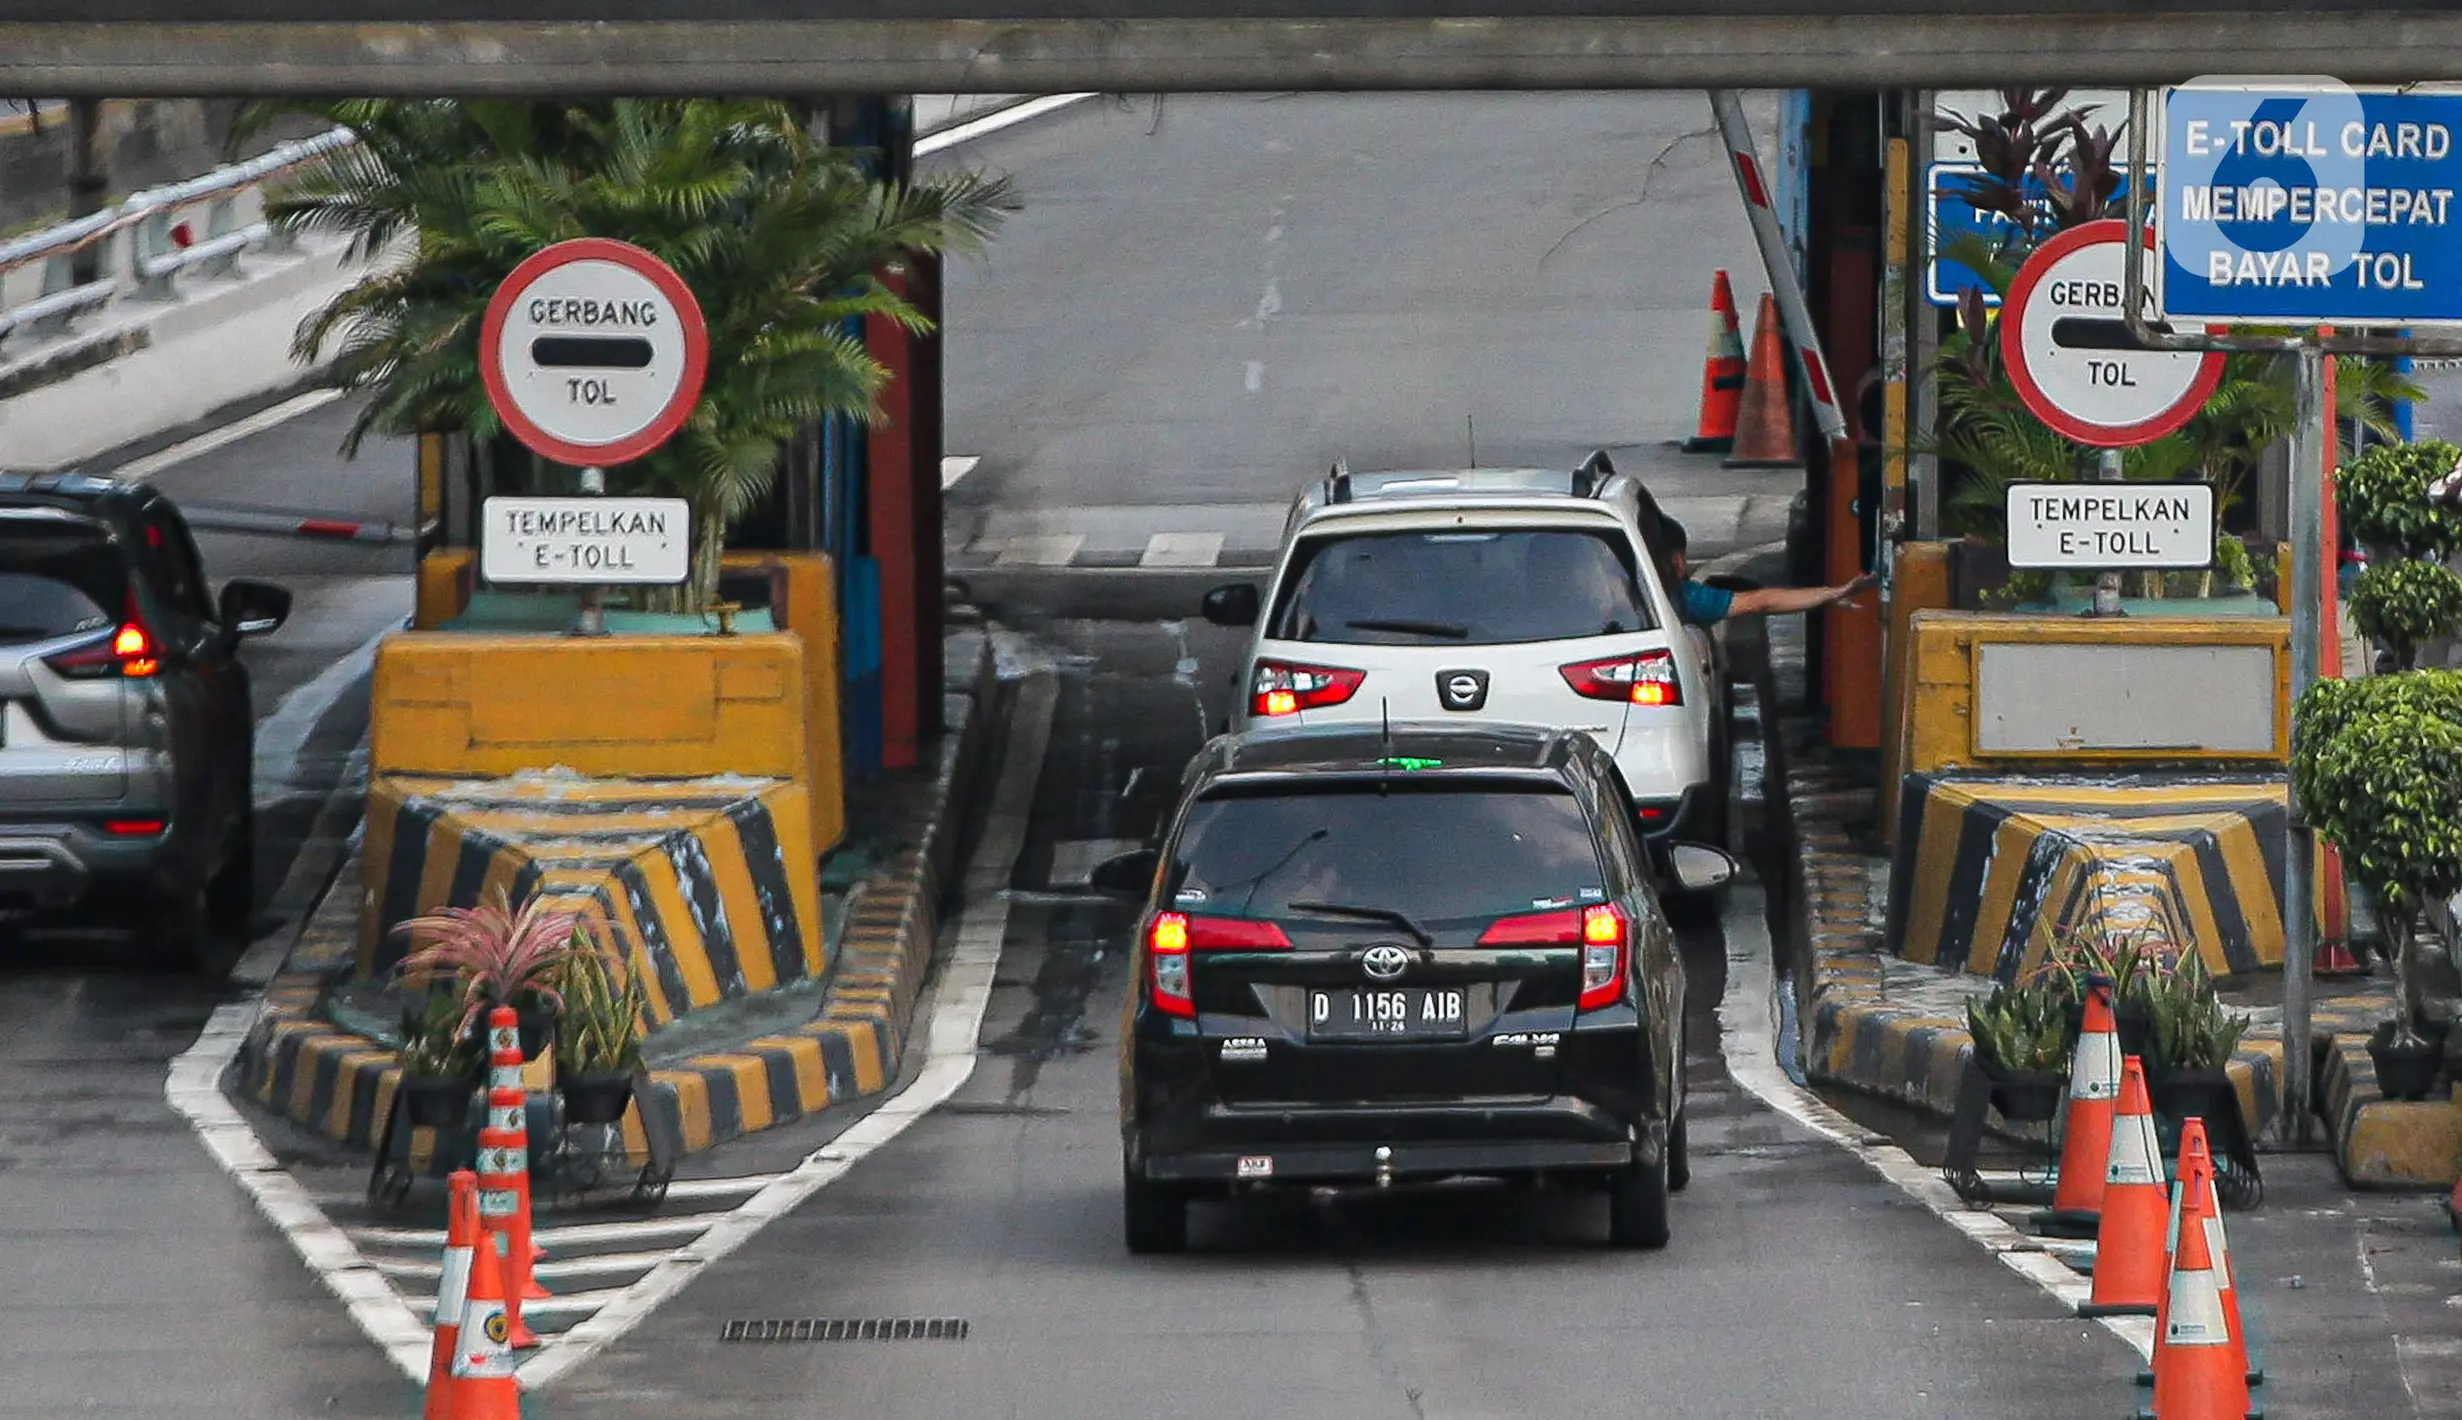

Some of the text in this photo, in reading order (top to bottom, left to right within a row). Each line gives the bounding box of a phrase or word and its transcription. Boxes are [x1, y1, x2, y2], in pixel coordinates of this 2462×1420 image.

[2186, 120, 2452, 160] E-TOLL CARD
[2181, 186, 2454, 226] MEMPERCEPAT
[2209, 250, 2424, 291] BAYAR TOL
[530, 300, 657, 325] GERBANG
[2088, 361, 2136, 386] TOL
[568, 378, 617, 404] TOL
[2030, 498, 2190, 521] TEMPELKAN
[506, 511, 666, 534] TEMPELKAN
[2060, 531, 2161, 555] E-TOLL
[536, 545, 634, 568] E-TOLL
[1314, 992, 1461, 1022] D 1156 AIB
